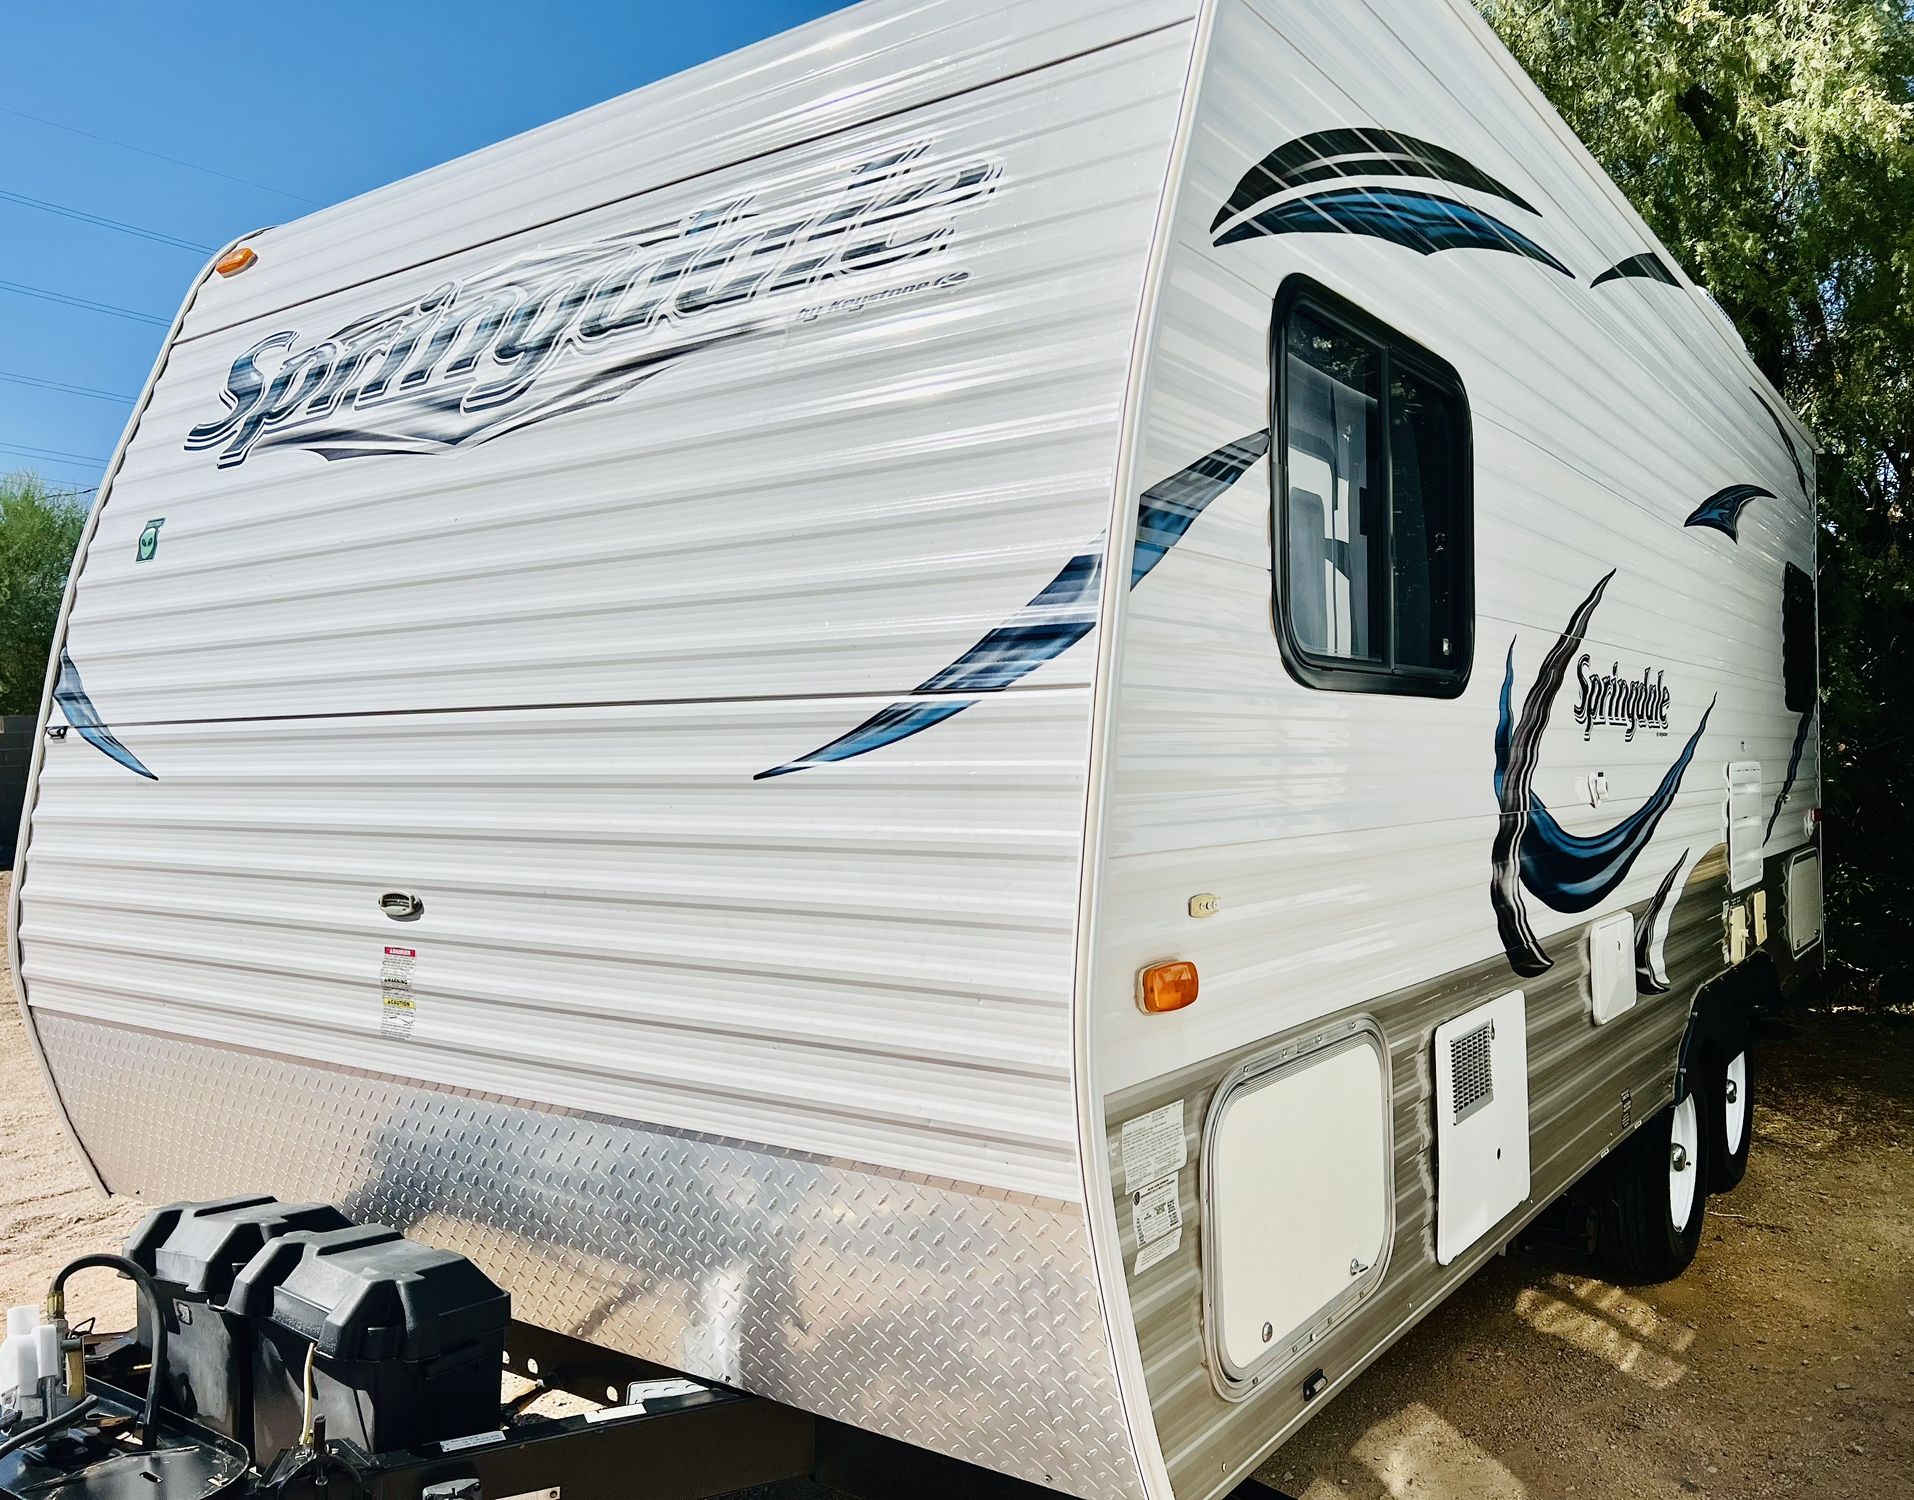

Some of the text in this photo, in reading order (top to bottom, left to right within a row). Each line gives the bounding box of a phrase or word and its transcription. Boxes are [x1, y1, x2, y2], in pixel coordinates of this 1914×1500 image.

[184, 137, 1006, 470] Springdale
[799, 281, 930, 322] by Keystone
[1573, 653, 1670, 743] Springdale
